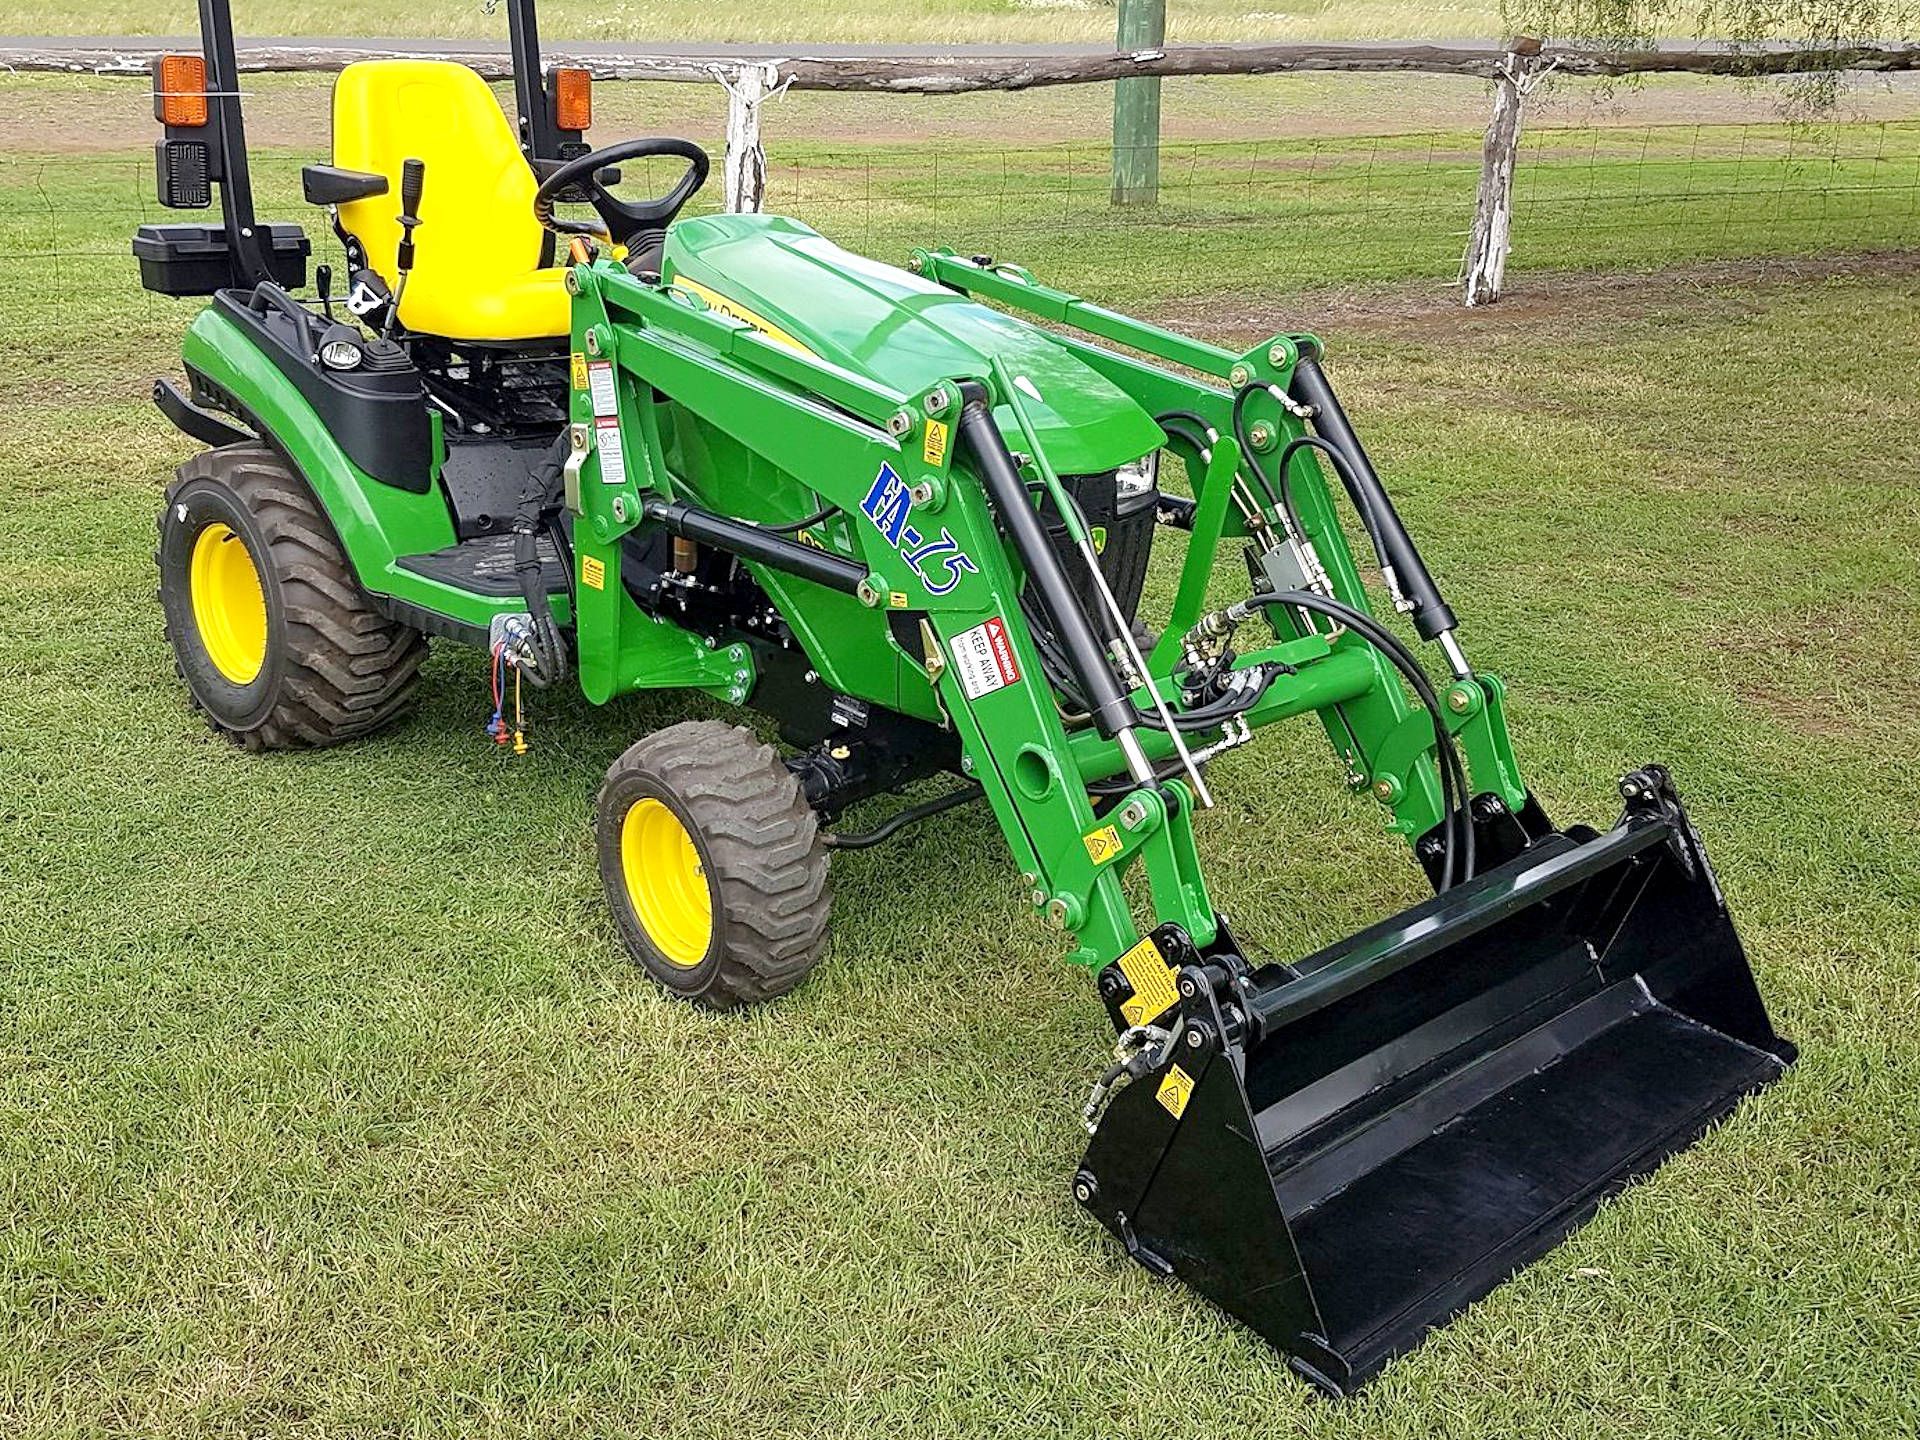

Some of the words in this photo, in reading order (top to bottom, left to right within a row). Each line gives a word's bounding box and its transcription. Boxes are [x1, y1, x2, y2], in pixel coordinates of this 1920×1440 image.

[859, 460, 980, 596] FA-15
[969, 629, 988, 655] KEEP
[979, 659, 999, 687] AWAY
[994, 634, 1017, 681] WARNING
[1153, 958, 1175, 992] CAUTION
